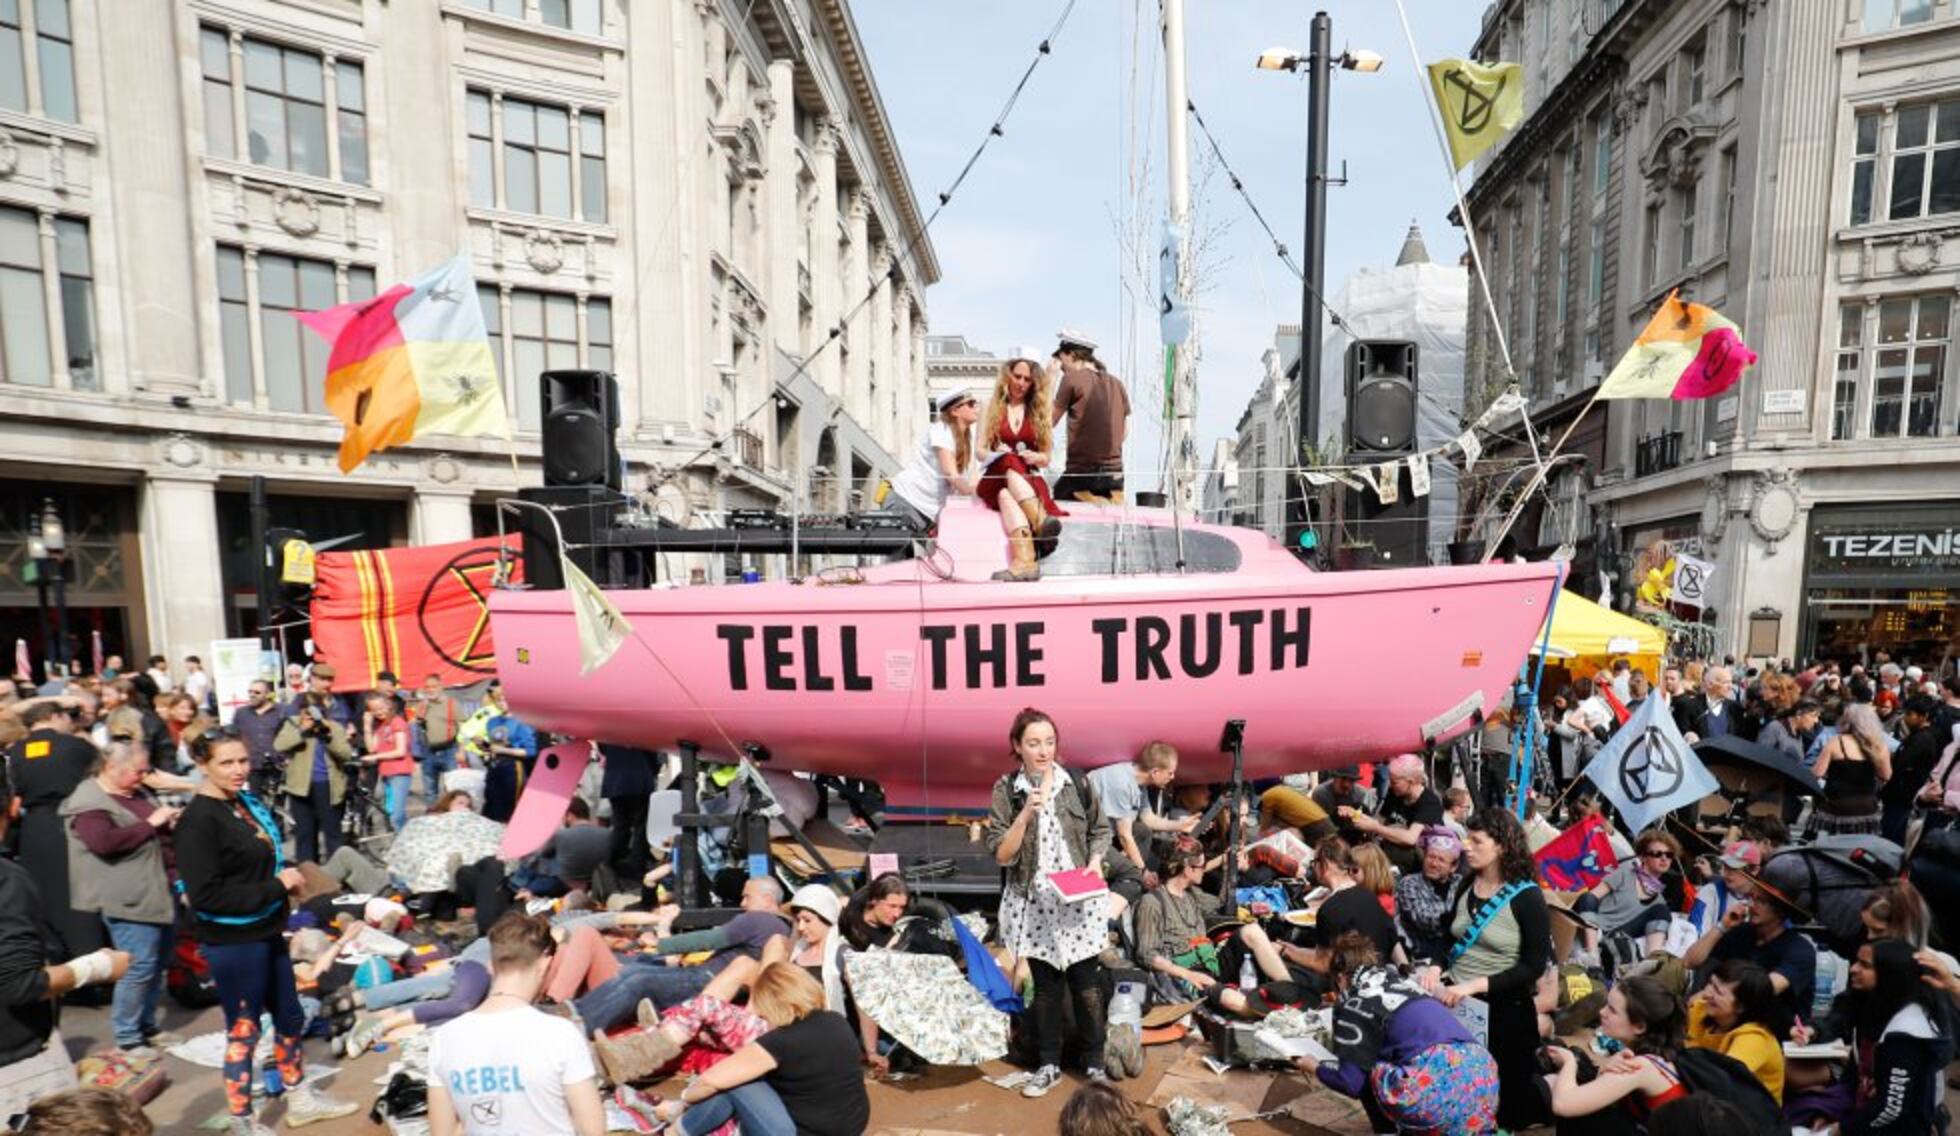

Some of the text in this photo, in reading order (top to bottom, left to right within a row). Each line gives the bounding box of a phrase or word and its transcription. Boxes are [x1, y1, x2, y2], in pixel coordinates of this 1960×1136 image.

[717, 624, 873, 691] TELL
[920, 622, 1045, 690] THE
[1092, 607, 1311, 684] TRUTH
[450, 1065, 526, 1095] REBEL
